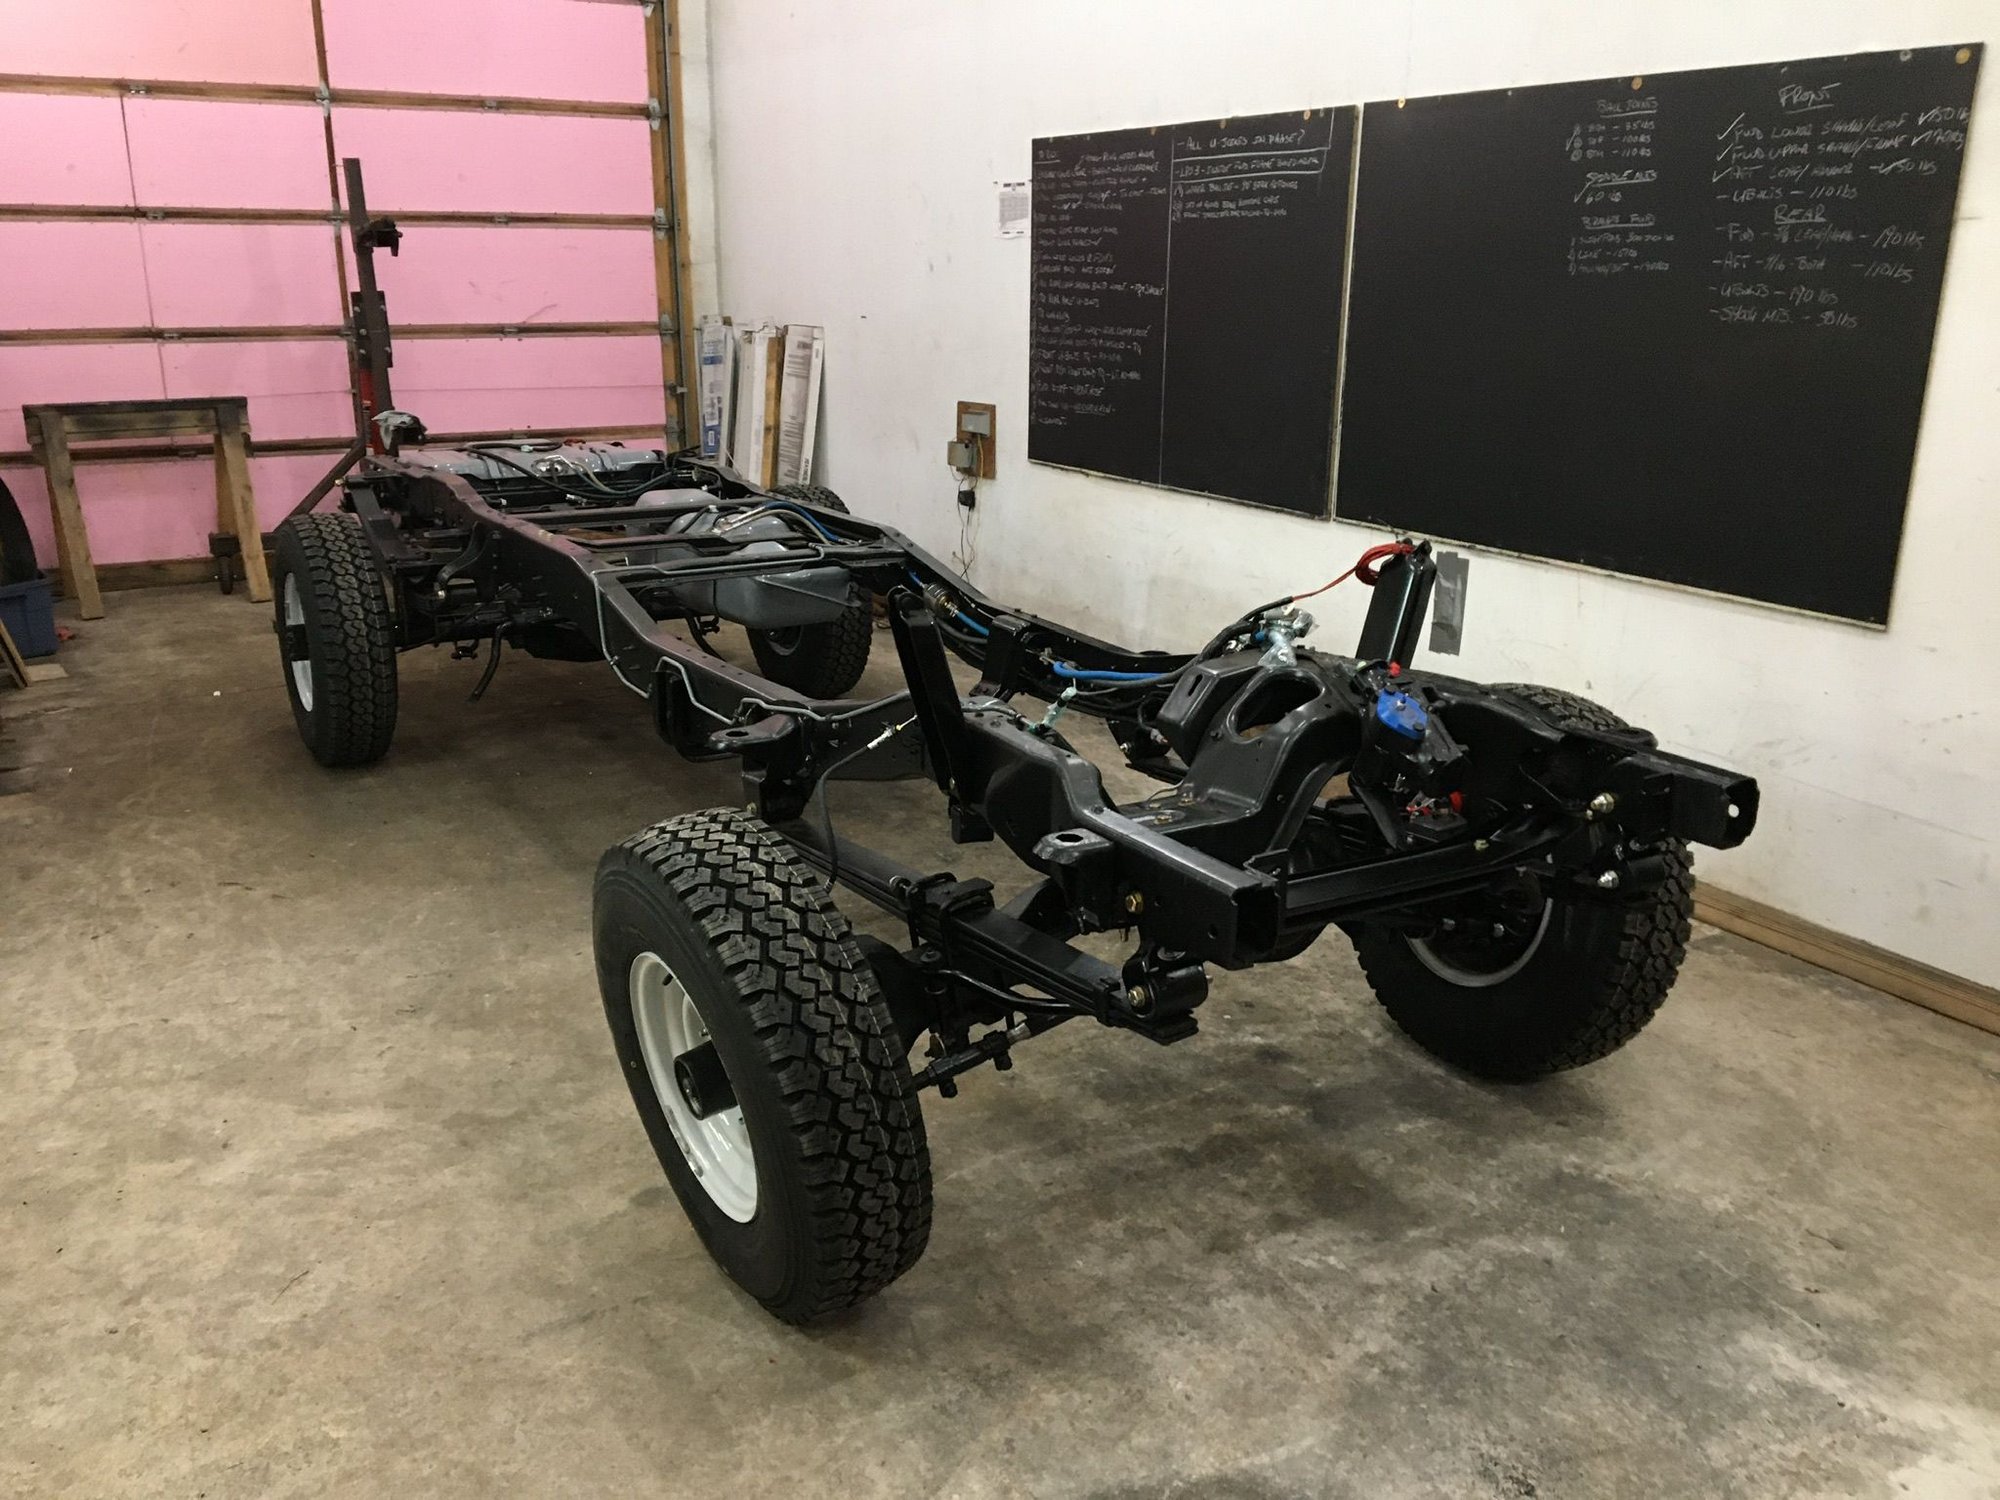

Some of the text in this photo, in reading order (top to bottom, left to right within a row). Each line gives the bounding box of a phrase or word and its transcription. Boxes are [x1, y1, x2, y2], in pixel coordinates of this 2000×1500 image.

[1779, 83, 1842, 108] FRONT
[1735, 123, 1764, 143] FWD
[1187, 137, 1202, 151] ALL
[1774, 203, 1828, 222] REAR
[1724, 254, 1752, 270] AFT
